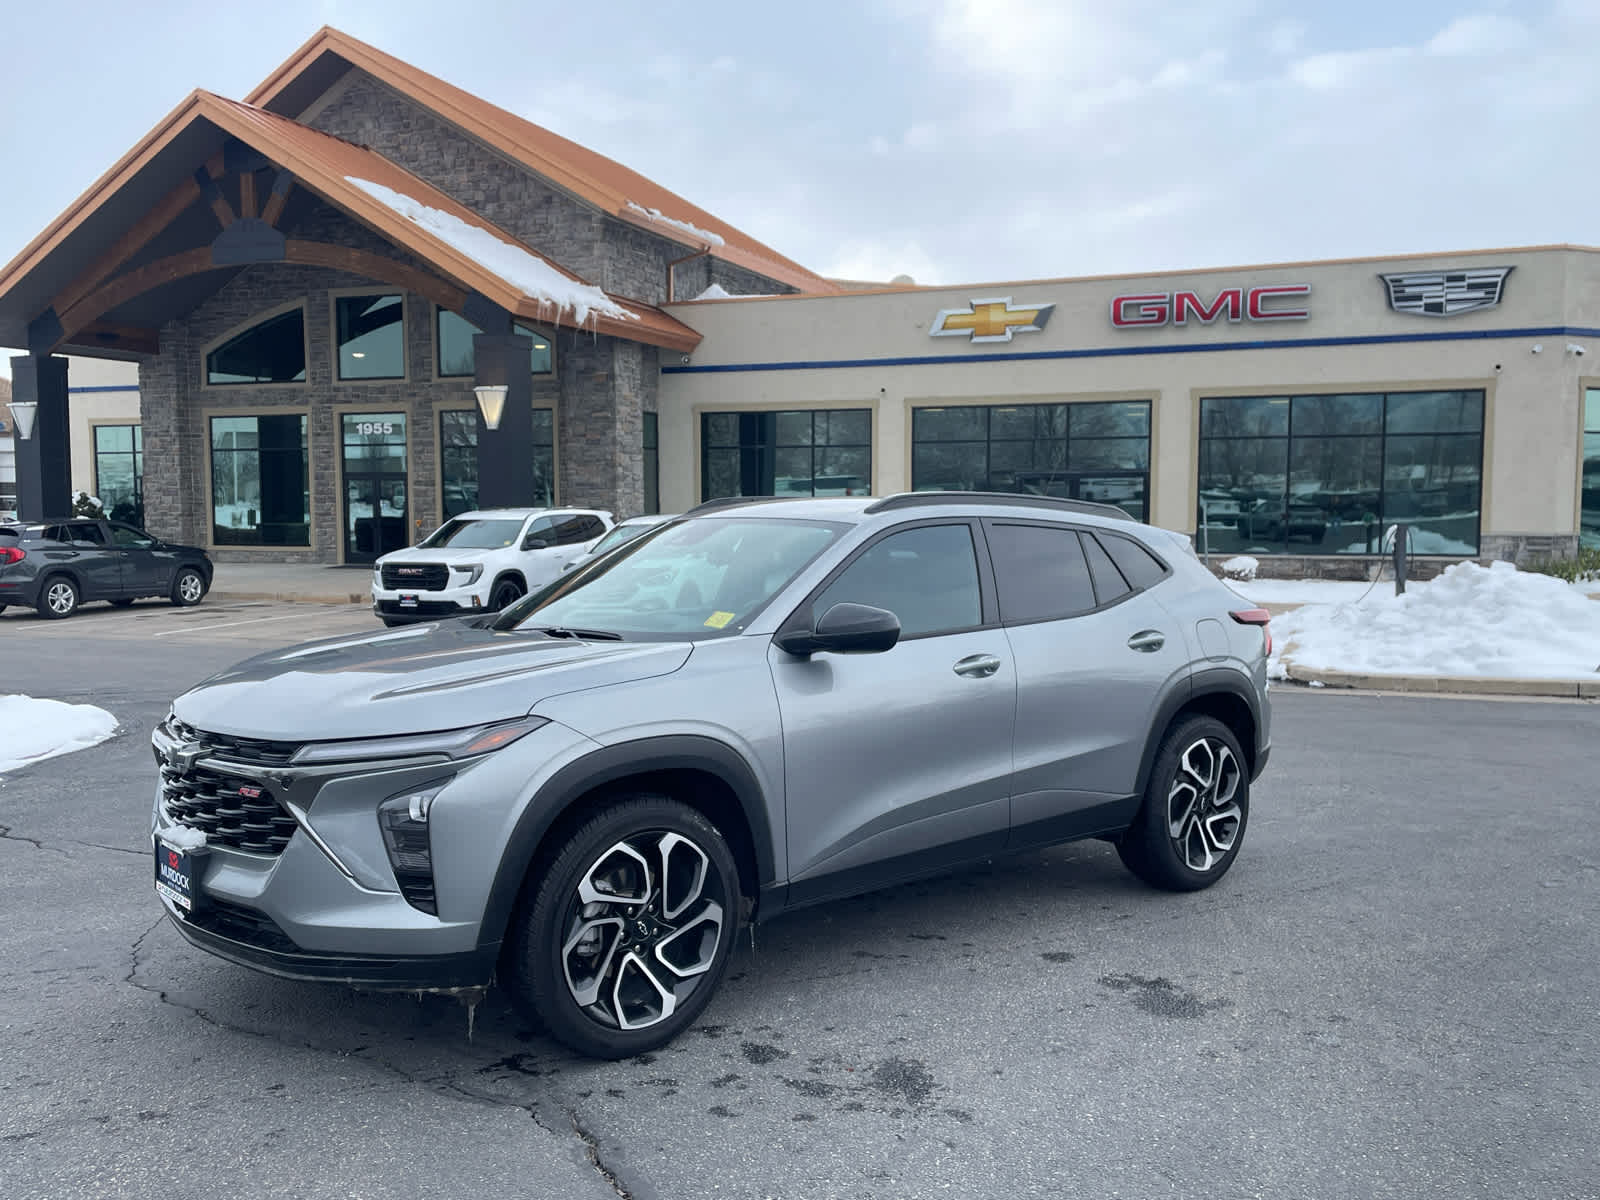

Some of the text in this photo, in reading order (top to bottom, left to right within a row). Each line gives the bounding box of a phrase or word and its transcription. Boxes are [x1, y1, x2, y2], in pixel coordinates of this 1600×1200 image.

[1111, 284, 1311, 328] GMC
[356, 423, 392, 435] 1955
[160, 863, 190, 890] MURDOCK
